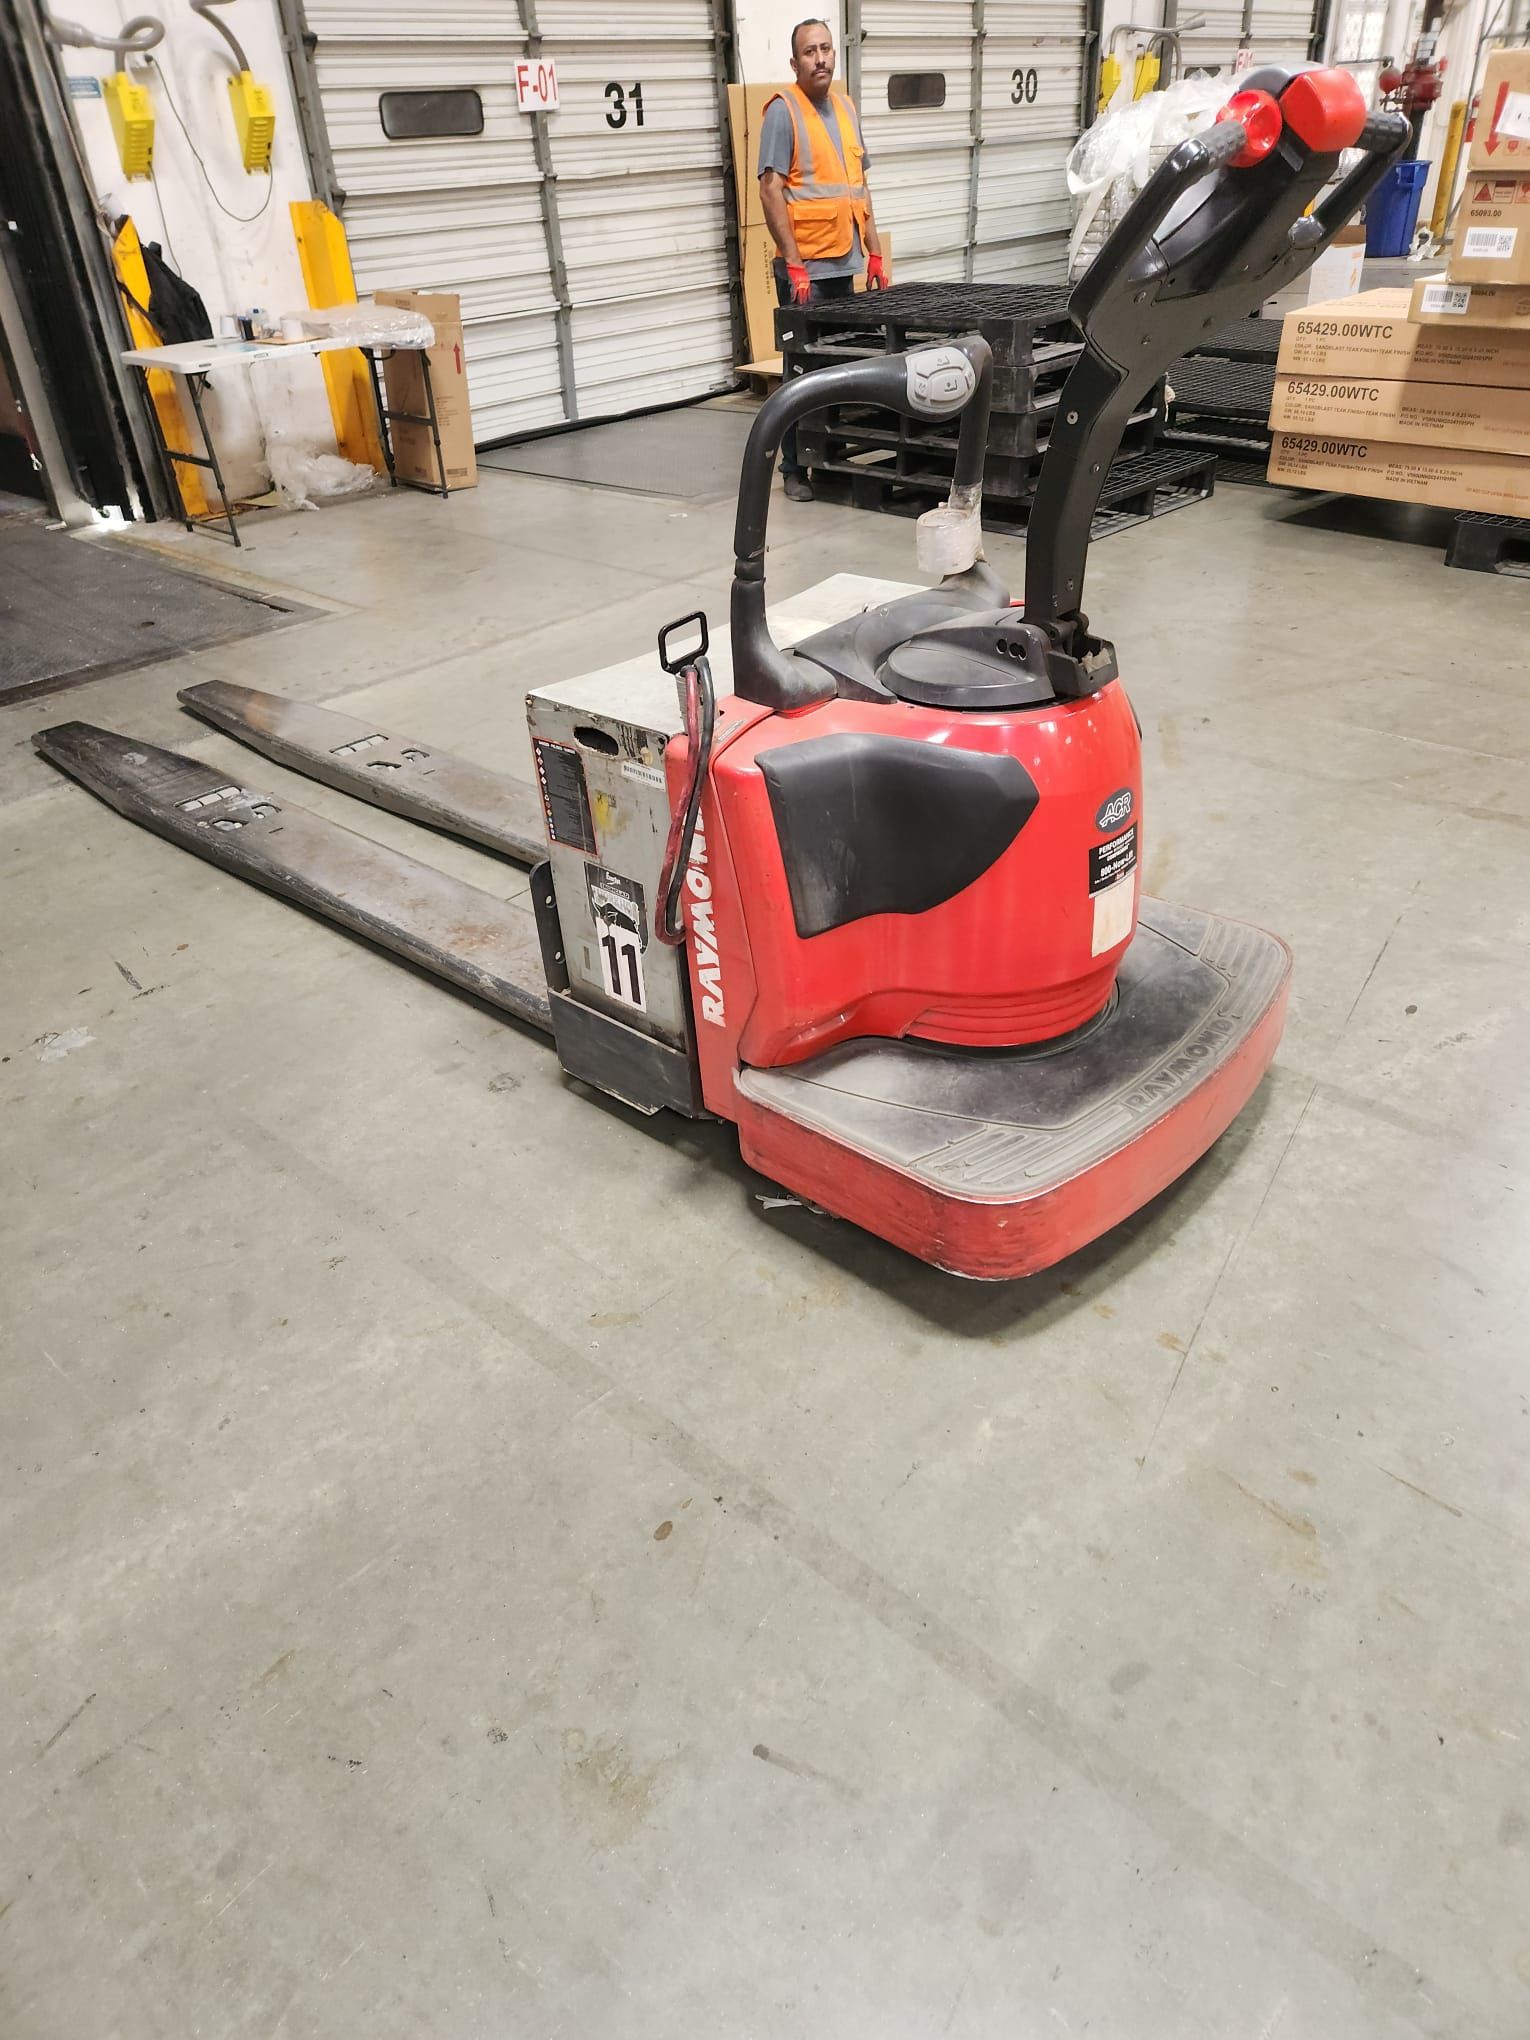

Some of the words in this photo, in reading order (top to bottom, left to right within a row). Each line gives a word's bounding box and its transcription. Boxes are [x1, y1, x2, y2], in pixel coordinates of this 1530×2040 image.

[517, 64, 557, 103] F-01
[1011, 68, 1038, 104] 30
[604, 82, 644, 129] 31
[1297, 321, 1393, 339] 65429.00WTC
[1287, 381, 1379, 401] 65429.00WTC
[1281, 436, 1368, 458] 65429.00WTC
[1101, 792, 1131, 824] ACR
[602, 934, 642, 1005] 11
[1119, 1019, 1233, 1113] RAYMOND
